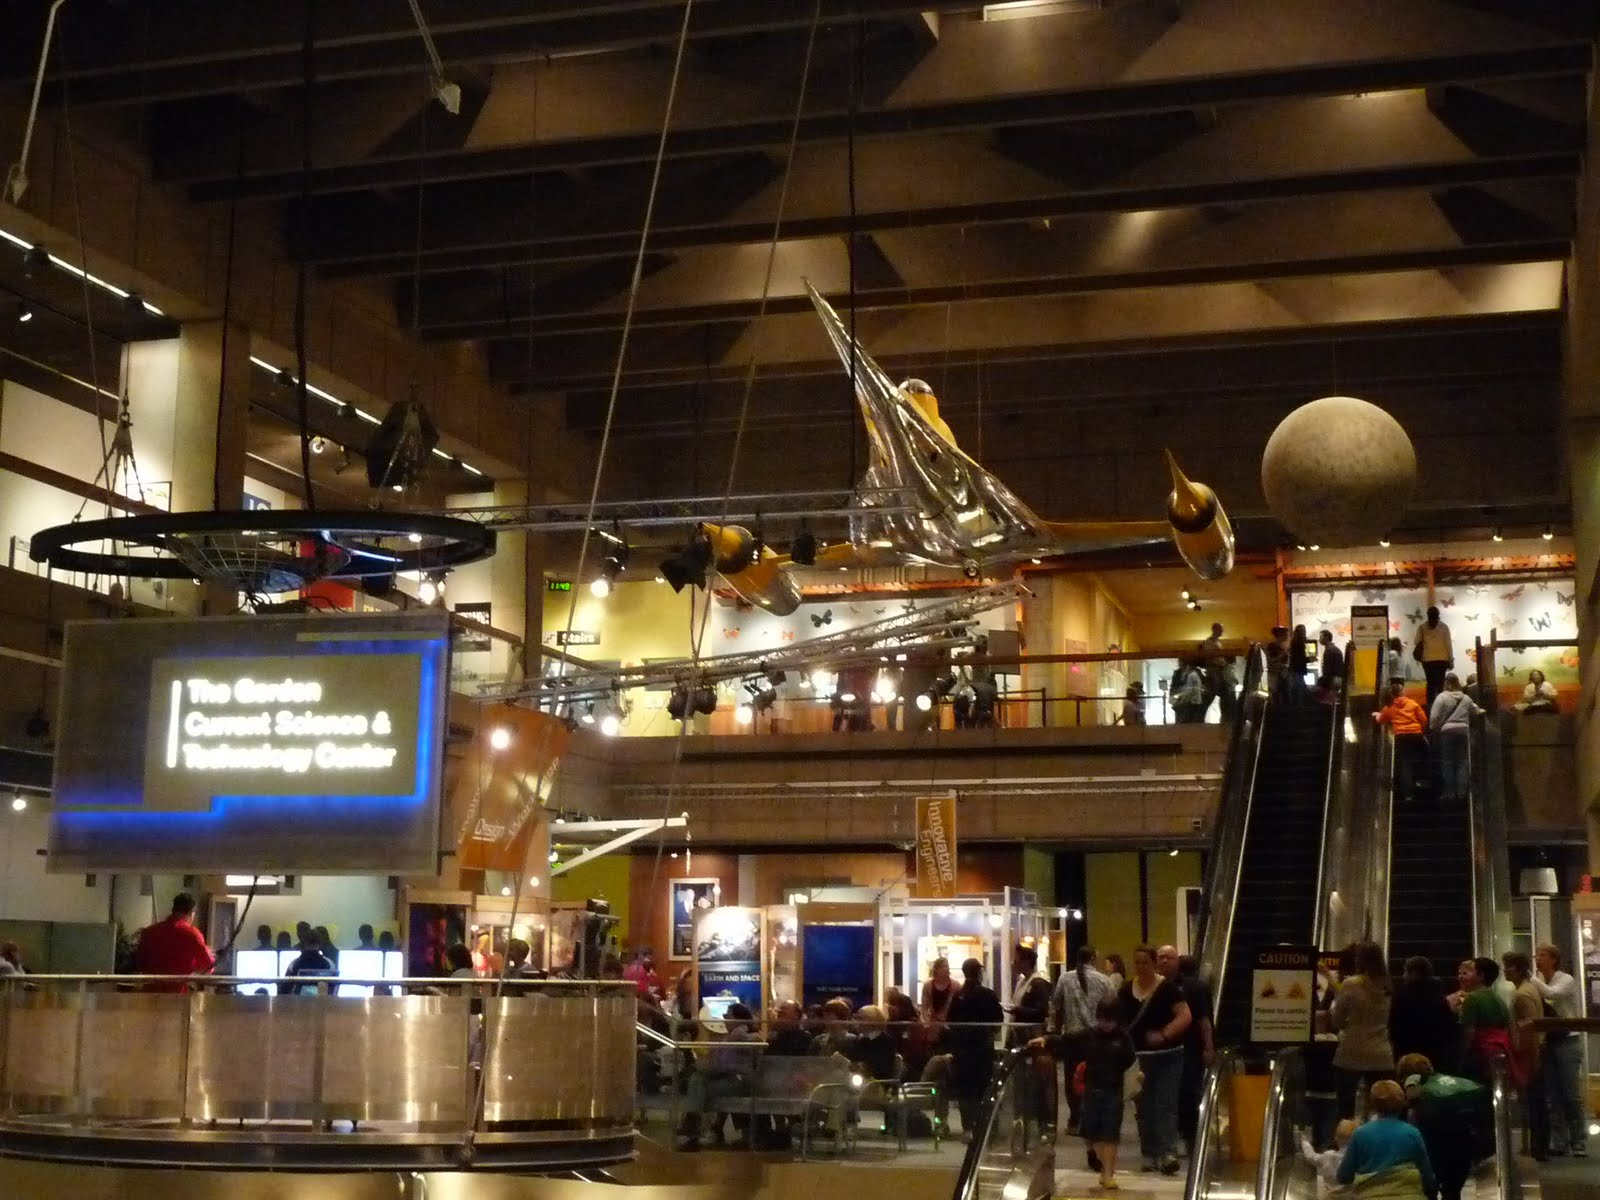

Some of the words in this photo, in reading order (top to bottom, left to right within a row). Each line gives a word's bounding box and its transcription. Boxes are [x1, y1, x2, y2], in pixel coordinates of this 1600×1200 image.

[187, 678, 231, 704] The
[184, 711, 271, 737] Current
[274, 710, 368, 736] Science
[371, 711, 392, 735] &
[182, 743, 313, 772] Technology
[315, 742, 397, 769] Center
[928, 800, 953, 882] Innovative
[1259, 953, 1309, 964] CAUTION
[725, 974, 740, 982] AND
[740, 974, 760, 982] SPACE
